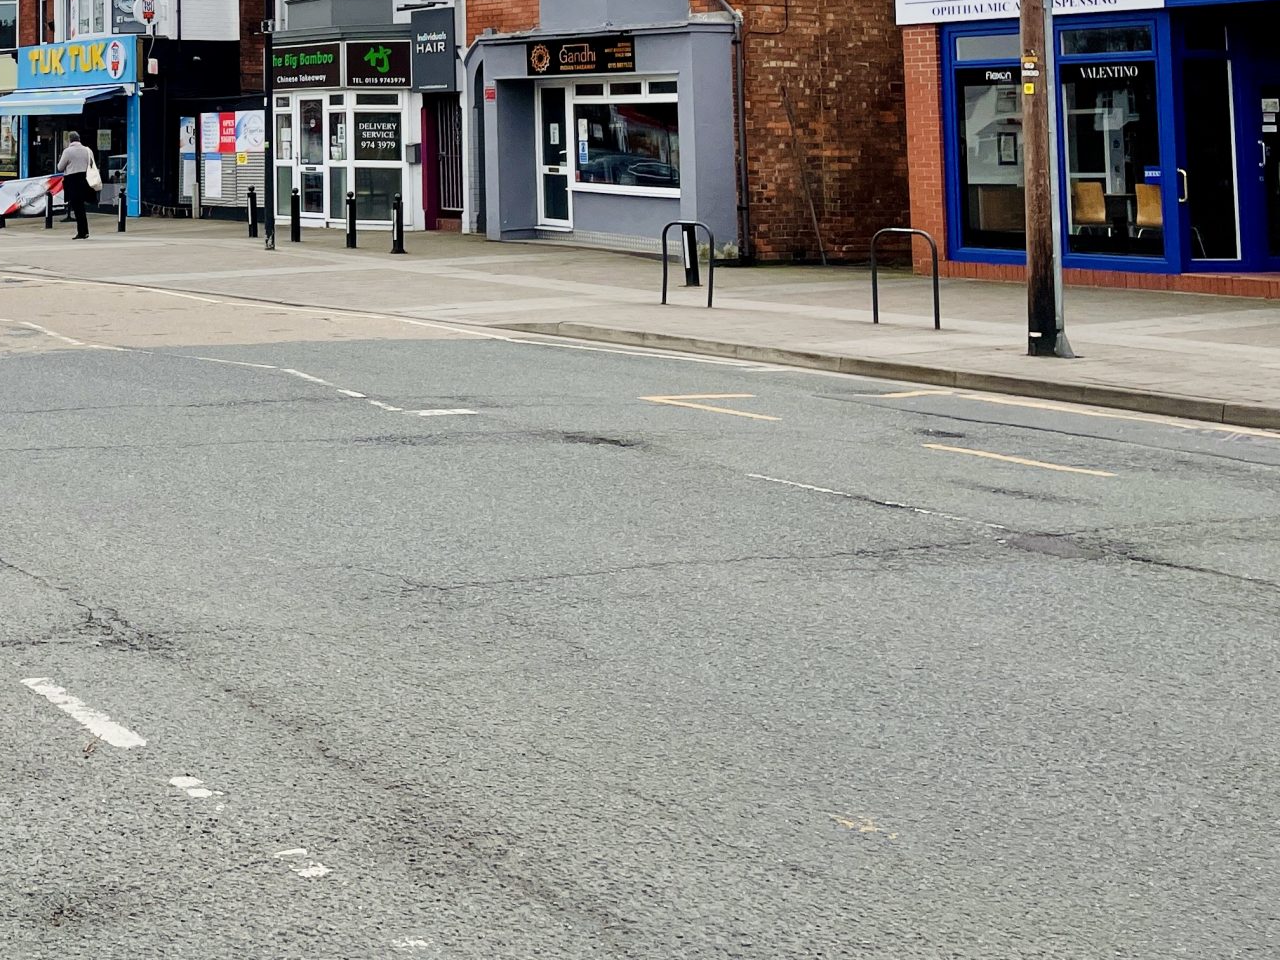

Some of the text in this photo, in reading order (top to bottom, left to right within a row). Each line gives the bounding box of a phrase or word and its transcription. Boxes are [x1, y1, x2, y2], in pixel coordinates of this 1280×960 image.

[932, 2, 1009, 16] OPHTHALMIC
[416, 42, 446, 54] HAIR
[559, 44, 596, 63] Gandhi
[28, 47, 65, 76] TUK
[68, 42, 107, 72] TUK
[272, 51, 333, 69] he Big Bamboo
[299, 74, 326, 82] Takeaway
[1080, 66, 1138, 79] VALENTINO
[359, 122, 397, 130] DELIVERY
[361, 141, 396, 149] 974 3979
